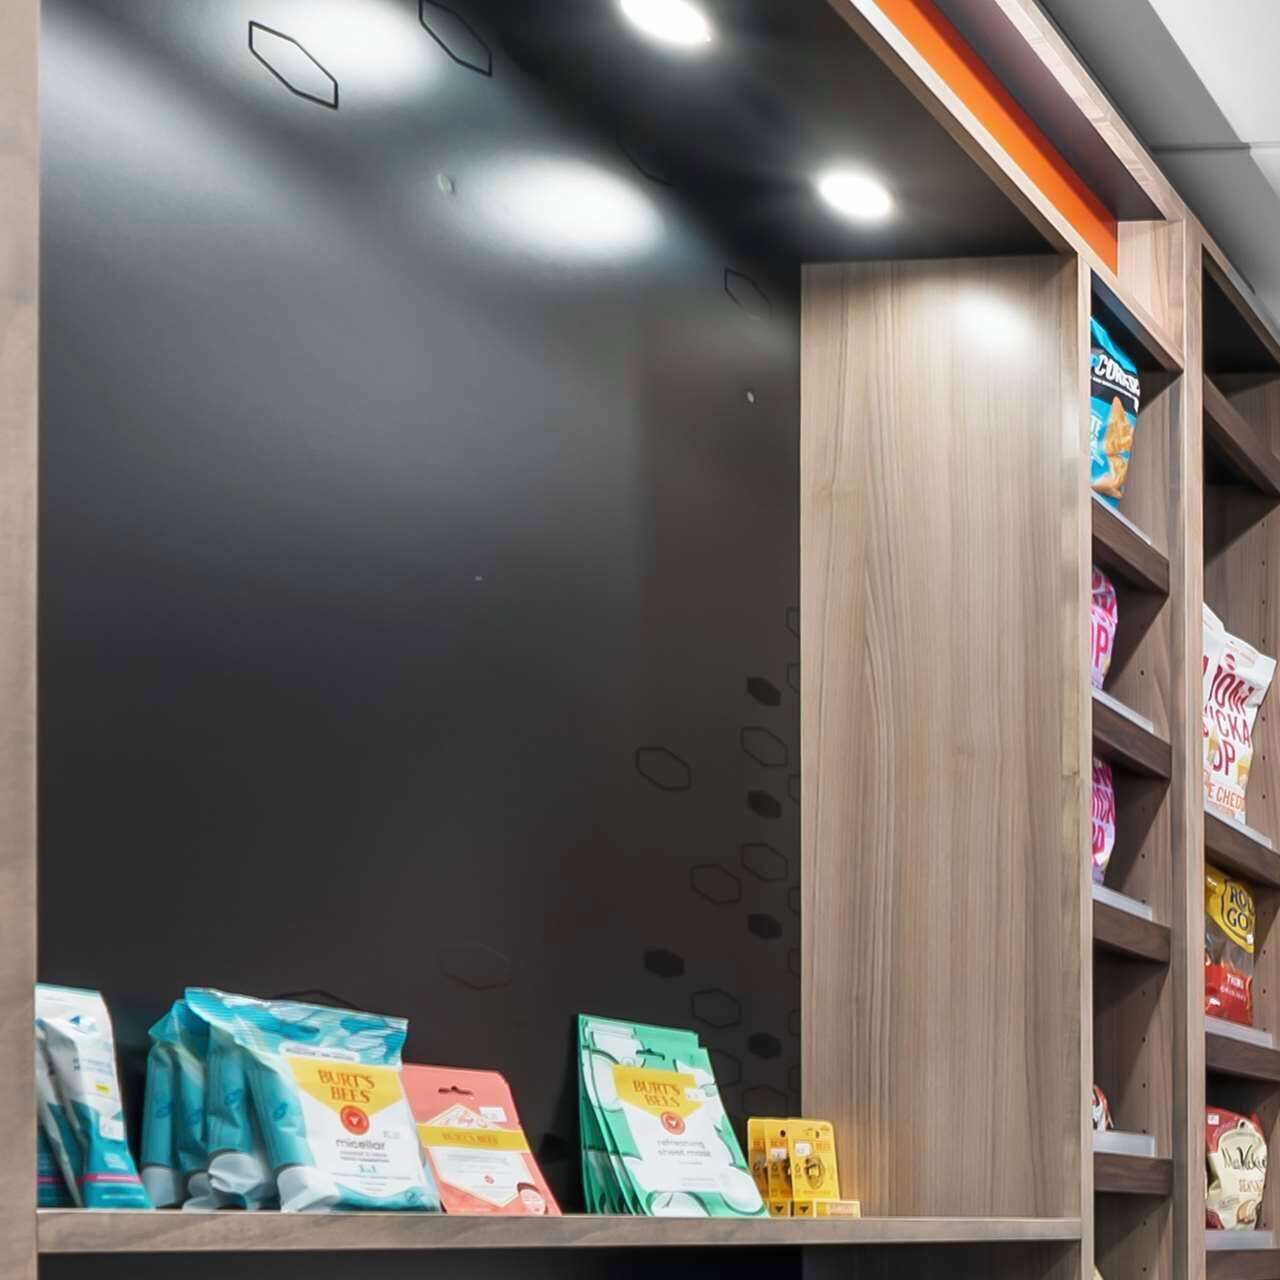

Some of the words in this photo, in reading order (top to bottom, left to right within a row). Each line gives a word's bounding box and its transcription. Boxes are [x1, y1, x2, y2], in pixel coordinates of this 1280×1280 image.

[317, 1068, 376, 1089] BURT'S
[330, 1086, 371, 1104] BEES
[632, 1080, 681, 1096] BURT'S
